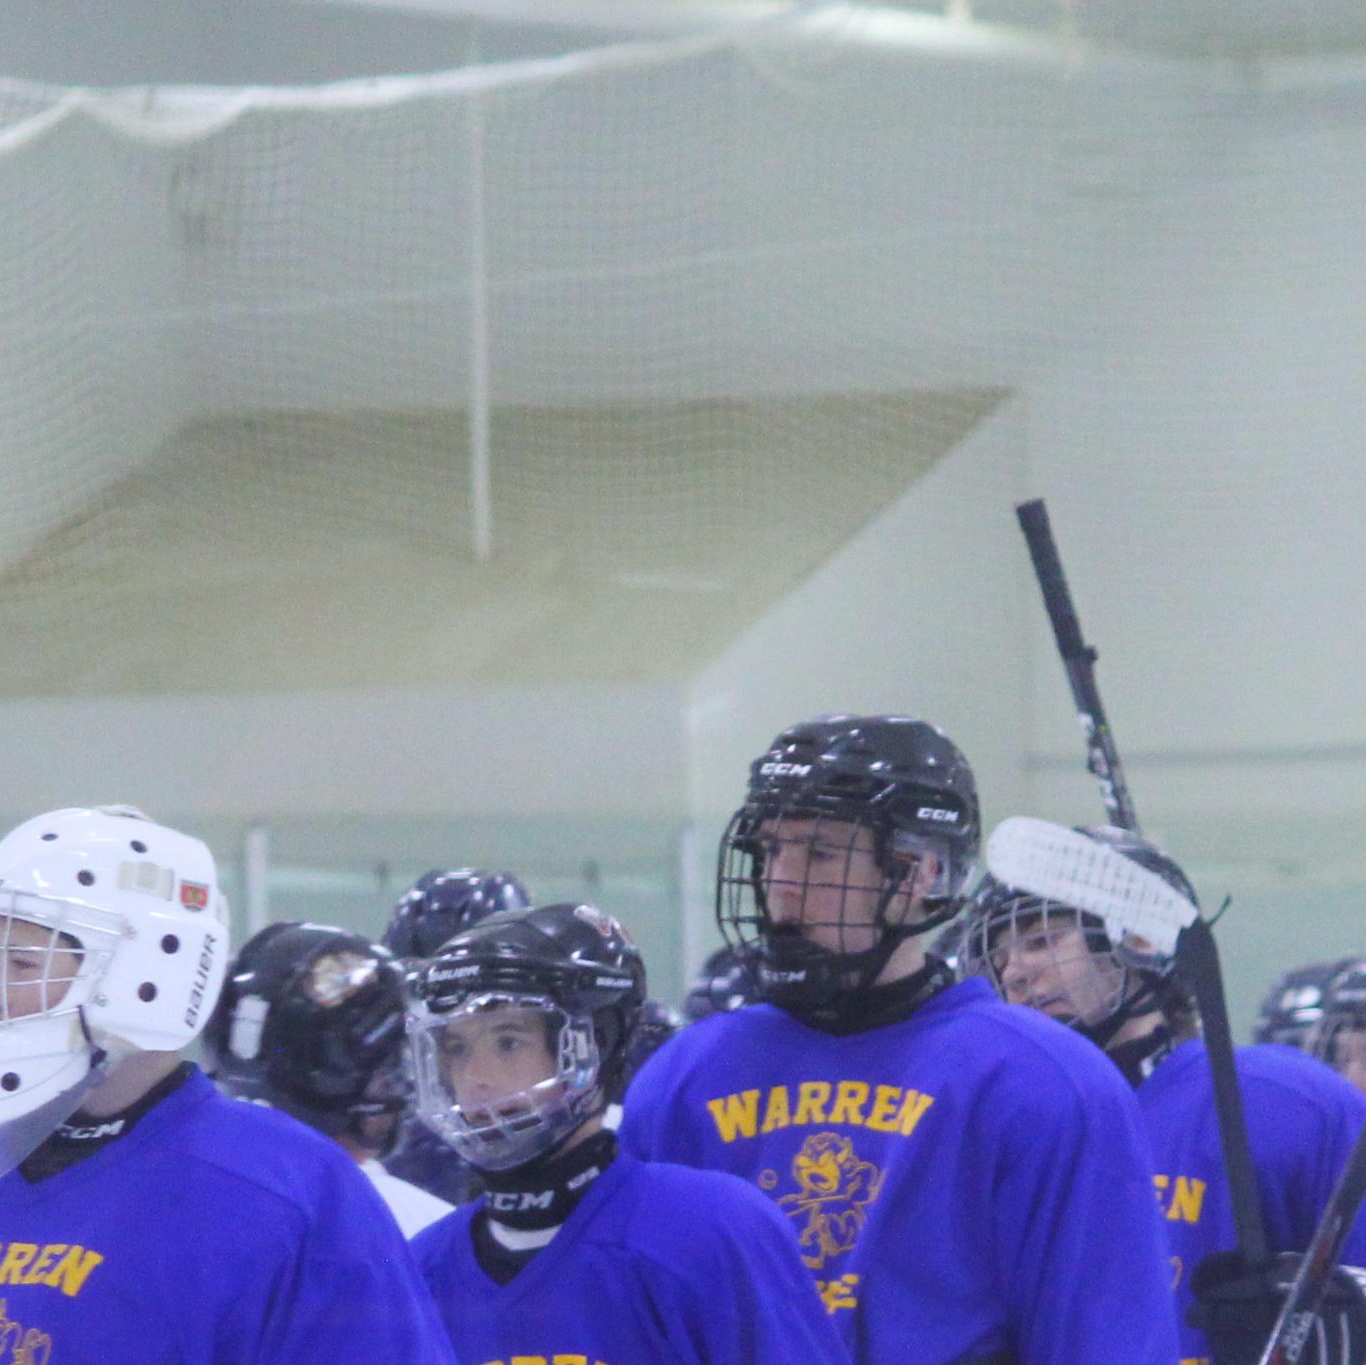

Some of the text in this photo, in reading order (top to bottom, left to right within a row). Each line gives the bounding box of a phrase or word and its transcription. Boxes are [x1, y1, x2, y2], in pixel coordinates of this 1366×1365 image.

[760, 762, 811, 777] CCM
[916, 806, 959, 822] CCM
[184, 932, 218, 1030] BAUER
[707, 1080, 935, 1144] WARREN
